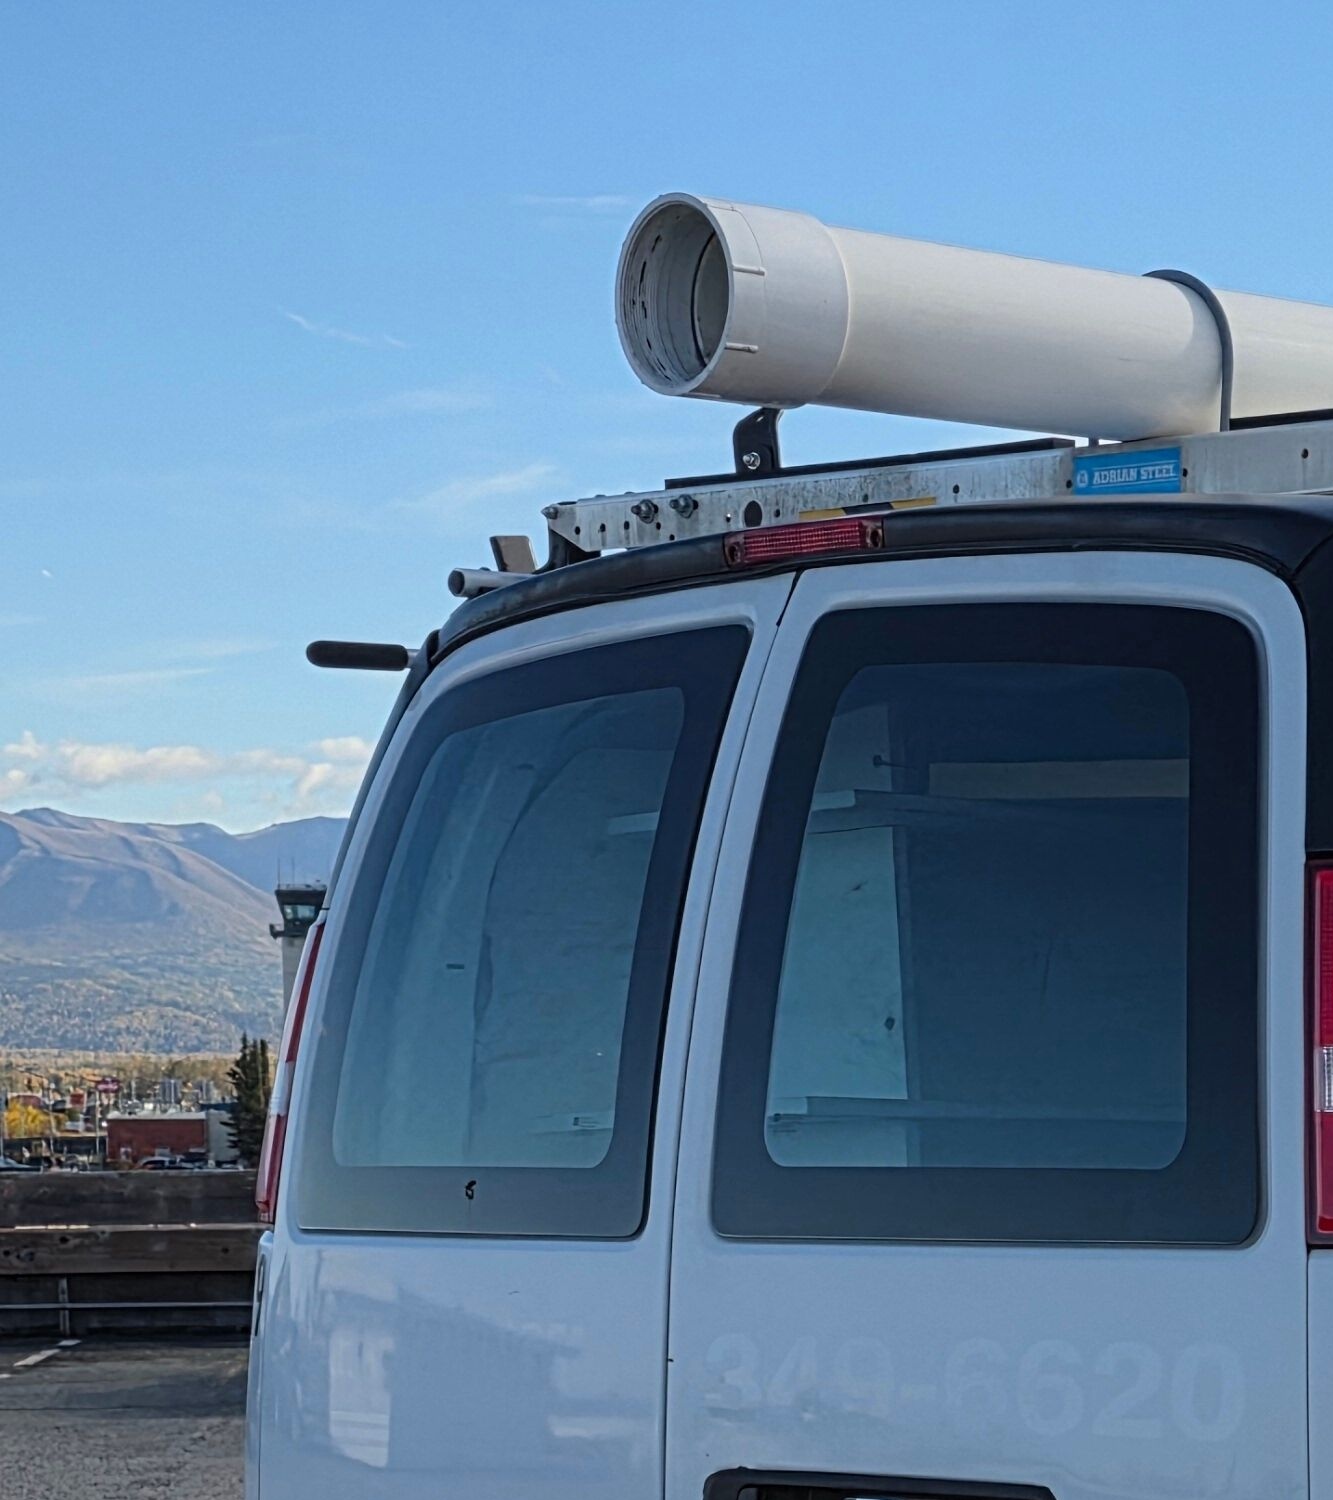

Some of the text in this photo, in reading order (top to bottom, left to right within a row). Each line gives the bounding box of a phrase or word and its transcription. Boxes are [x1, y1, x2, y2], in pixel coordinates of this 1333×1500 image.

[1093, 464, 1176, 485] ADRIAN STEEL
[703, 1332, 1247, 1443] 349-6620
